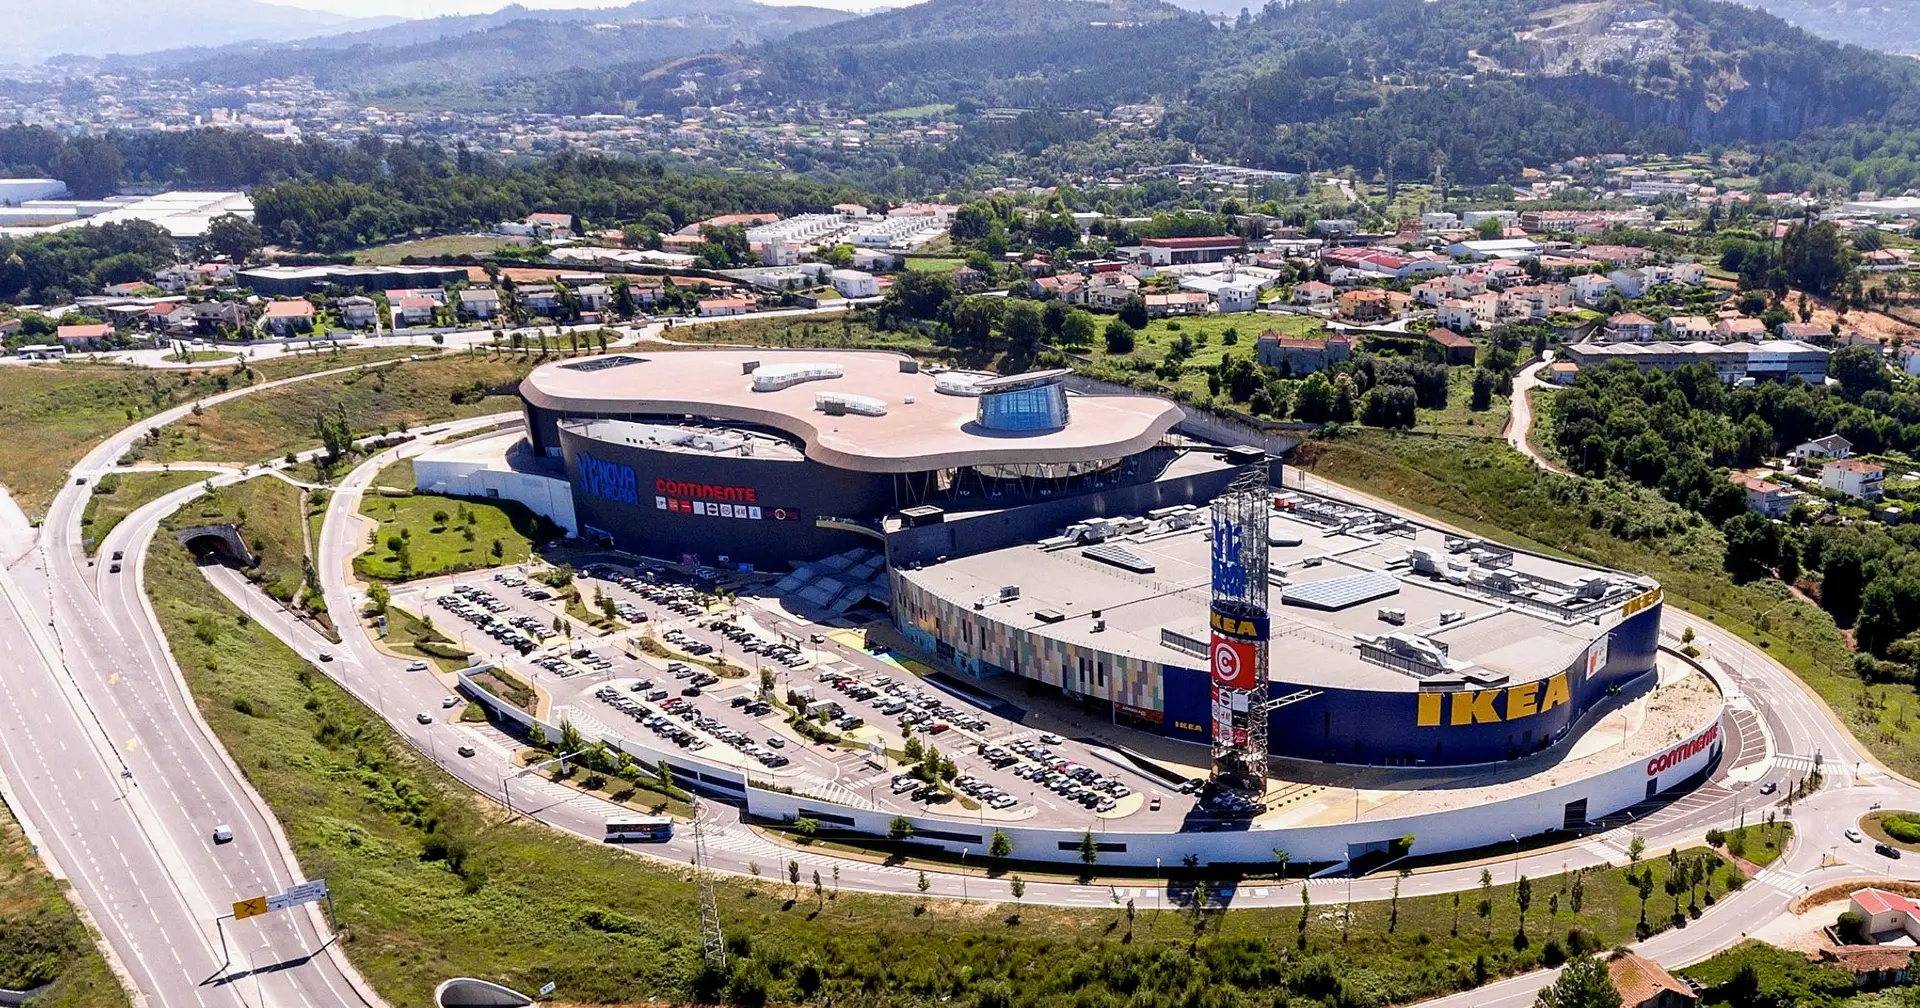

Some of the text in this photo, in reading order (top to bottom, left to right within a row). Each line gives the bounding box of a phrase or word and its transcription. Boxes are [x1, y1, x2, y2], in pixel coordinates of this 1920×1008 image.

[598, 460, 637, 489] NOVA
[656, 478, 757, 503] CONTINENTE
[1417, 672, 1571, 726] IKEA
[1175, 721, 1203, 732] IKEA
